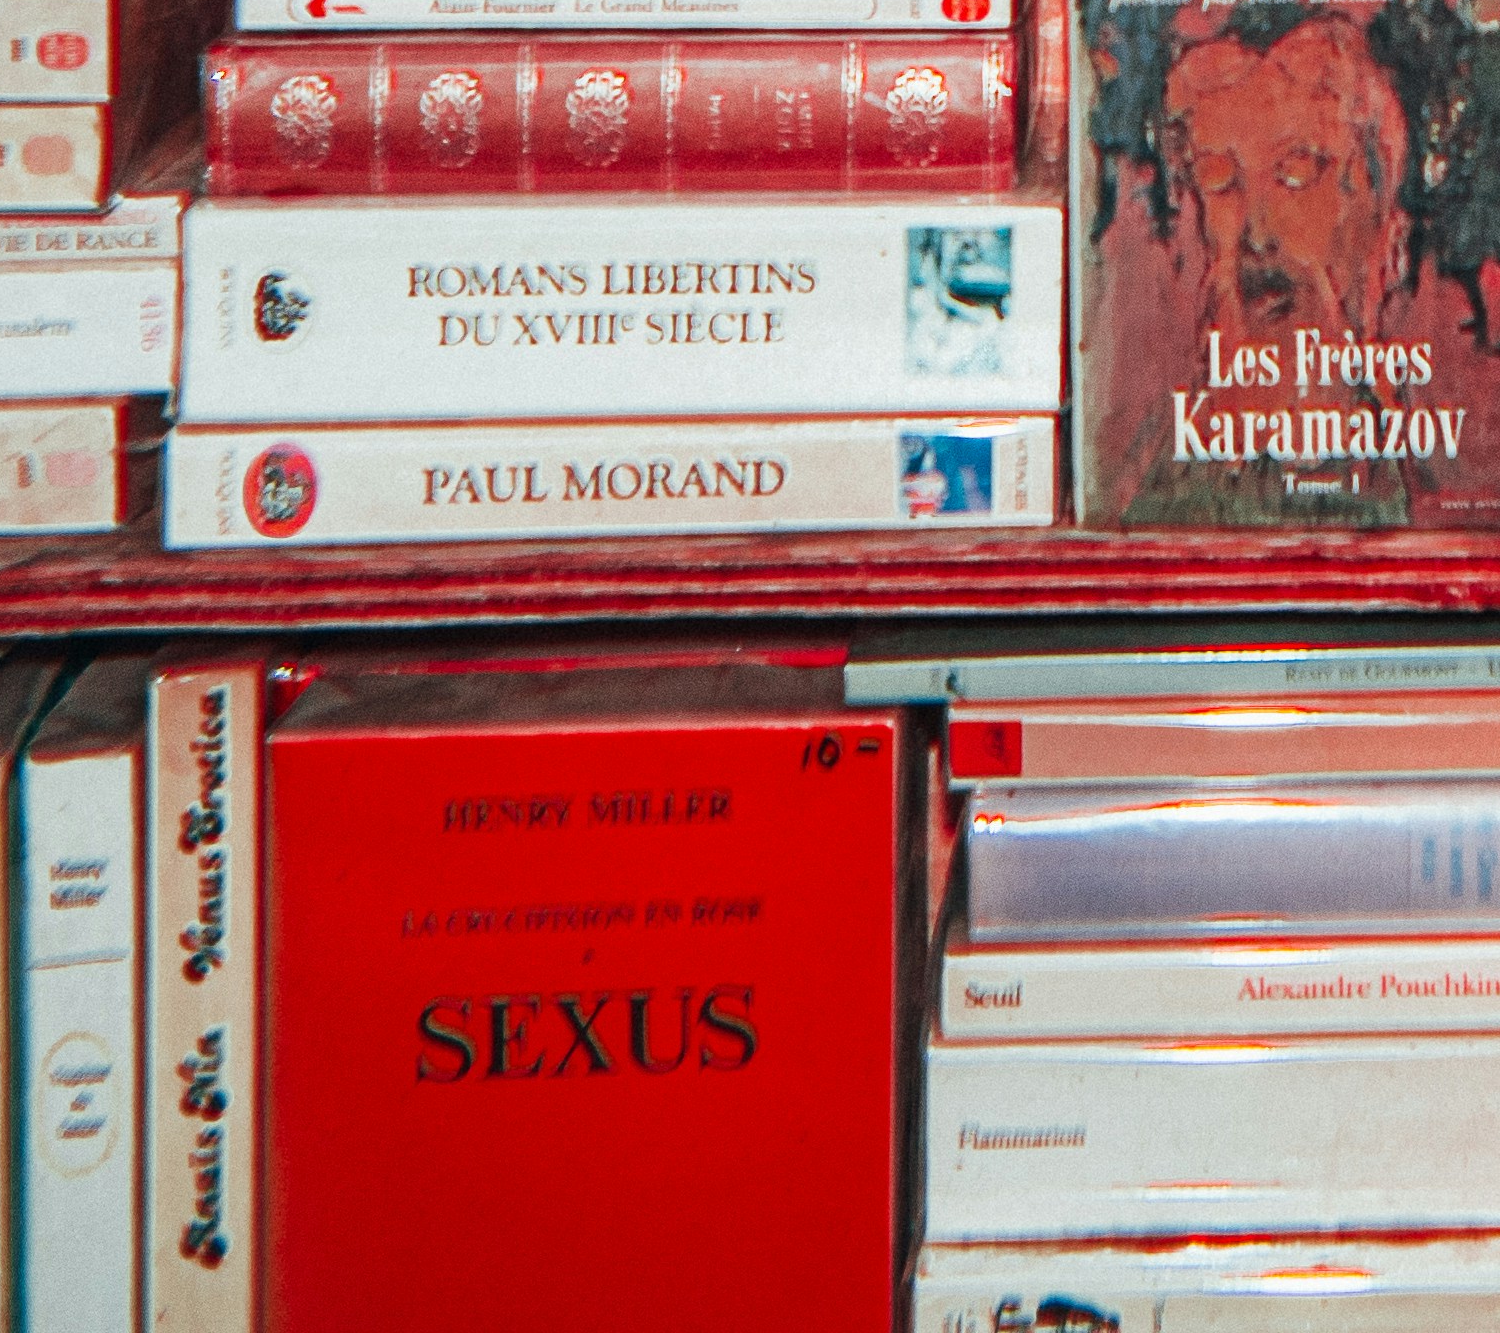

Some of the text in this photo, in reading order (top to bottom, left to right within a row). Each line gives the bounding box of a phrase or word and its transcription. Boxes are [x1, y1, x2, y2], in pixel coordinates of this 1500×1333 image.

[35, 231, 72, 252] DE
[407, 262, 818, 300] ROMANS LIBERTINS
[436, 301, 786, 348] DU SIÈCLE
[1207, 327, 1433, 389] Les Frères
[1172, 389, 1468, 463] Karamazov
[421, 456, 787, 507] PAUL MORAND
[1281, 472, 1343, 495] Tome
[443, 787, 735, 834] HENRY MILLER
[962, 979, 1023, 1012] Seuil
[1237, 971, 1371, 1005] Alexandre
[415, 984, 760, 1085] SEXUS
